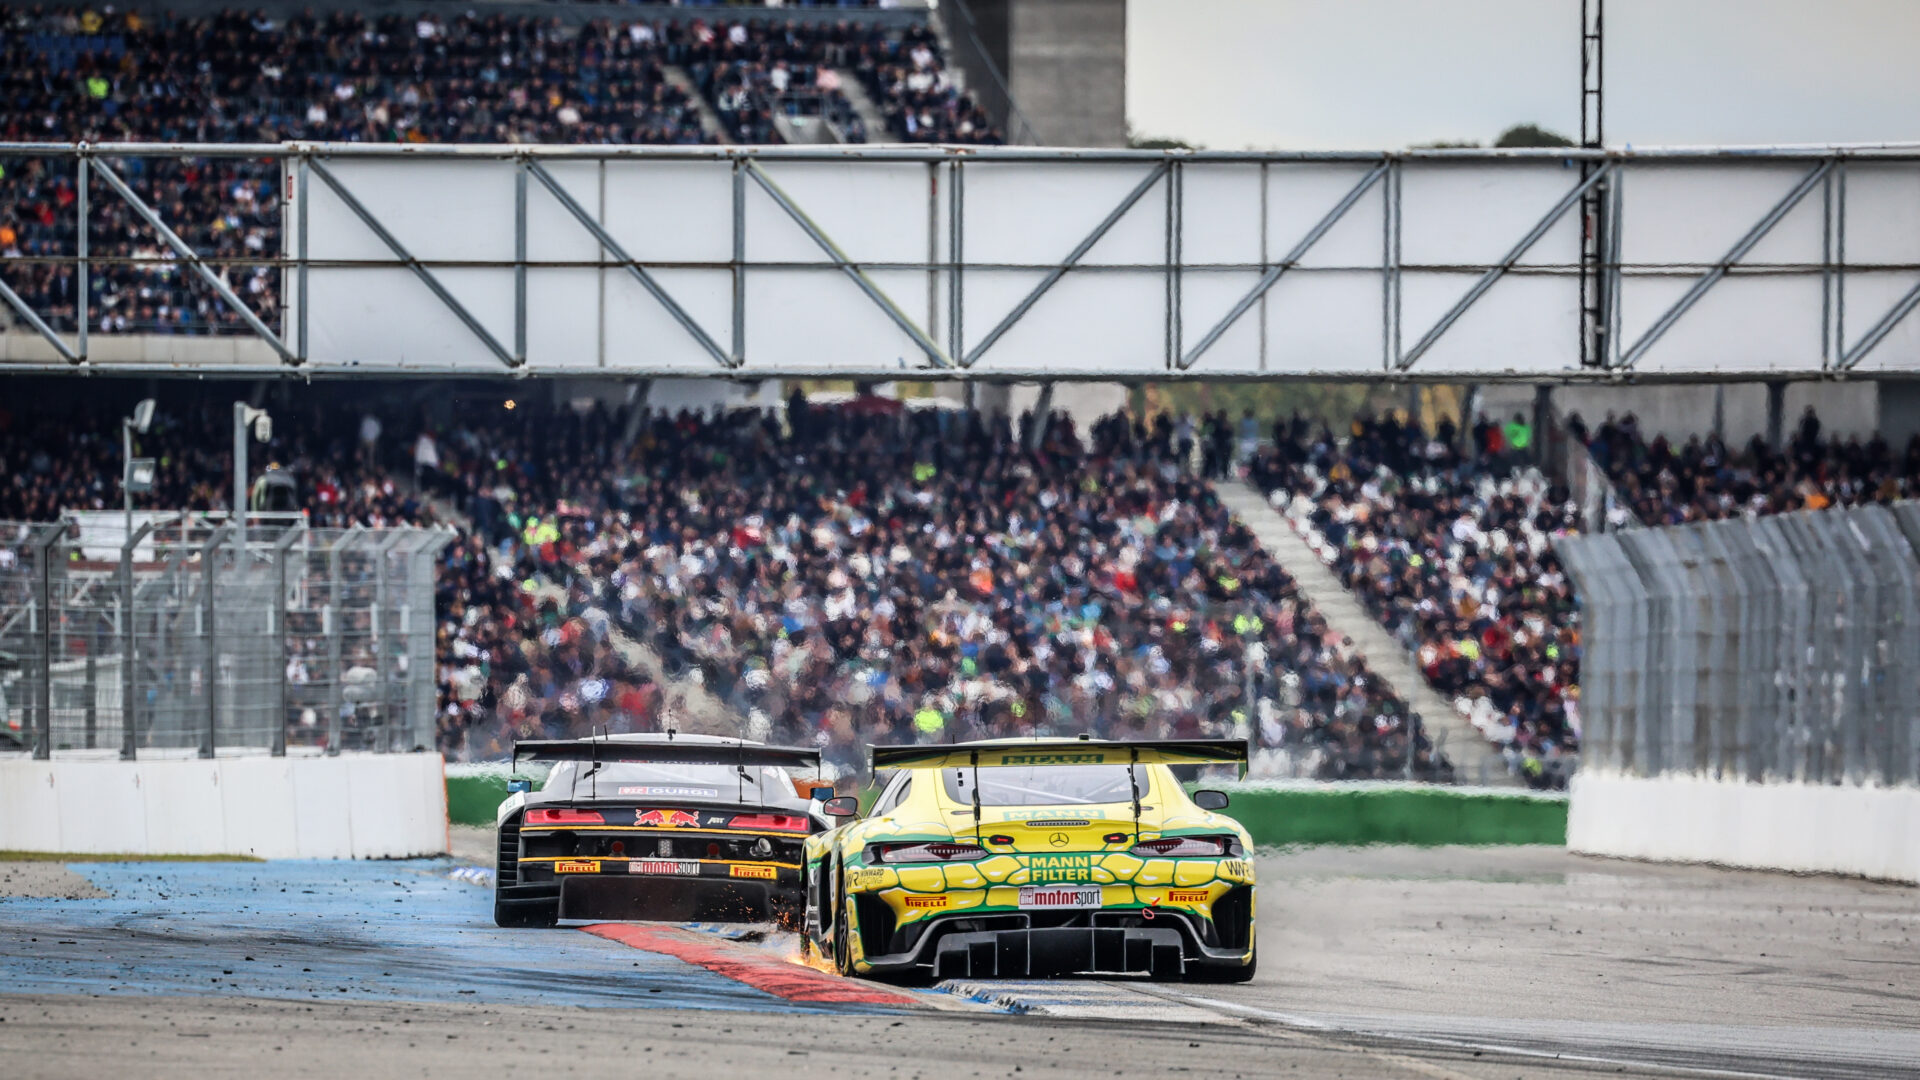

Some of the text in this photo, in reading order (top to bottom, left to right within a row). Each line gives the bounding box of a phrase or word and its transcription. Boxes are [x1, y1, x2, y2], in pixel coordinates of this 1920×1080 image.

[651, 787, 712, 797] GURGL
[1007, 809, 1099, 820] MANN
[559, 863, 596, 873] PIRELLI
[1031, 856, 1088, 868] MANN
[734, 867, 771, 877] PIRELLI
[1032, 868, 1089, 881] FILTER
[905, 895, 947, 908] PIRELLI
[1034, 889, 1100, 907] motorsport
[1168, 890, 1209, 902] PIRELLI
